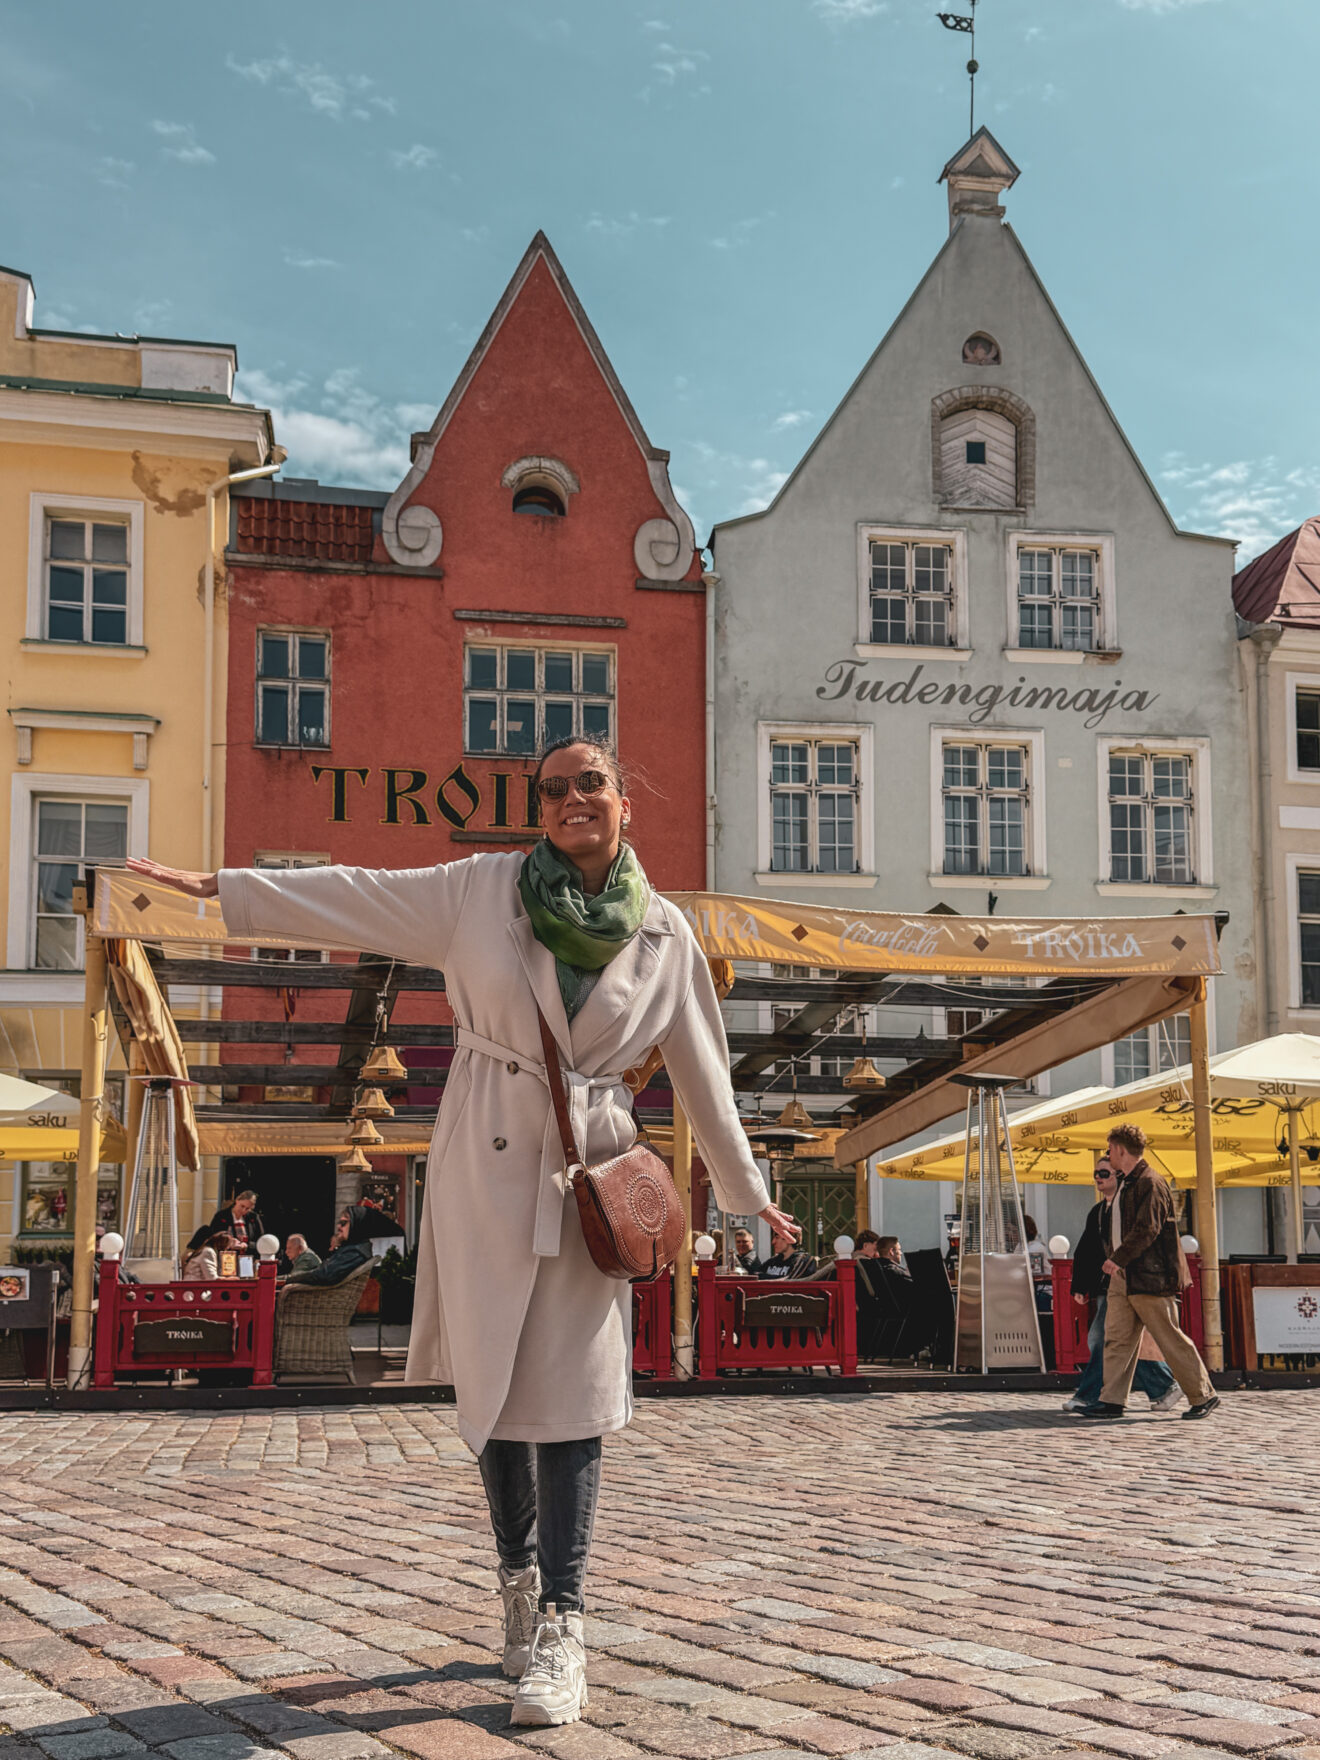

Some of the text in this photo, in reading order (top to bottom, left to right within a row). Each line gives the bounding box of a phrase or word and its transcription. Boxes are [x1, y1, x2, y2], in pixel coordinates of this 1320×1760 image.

[816, 659, 1160, 729] Tudengimaja
[311, 761, 543, 832] TROI
[1016, 930, 1144, 961] TROIKA
[1160, 1086, 1182, 1104] saku
[1258, 1082, 1296, 1095] saku
[1108, 1100, 1128, 1115] saku
[28, 1112, 67, 1128] saku
[1060, 1112, 1078, 1127] saku
[770, 1305, 803, 1313] TROIKA
[166, 1330, 204, 1340] TROIKA
